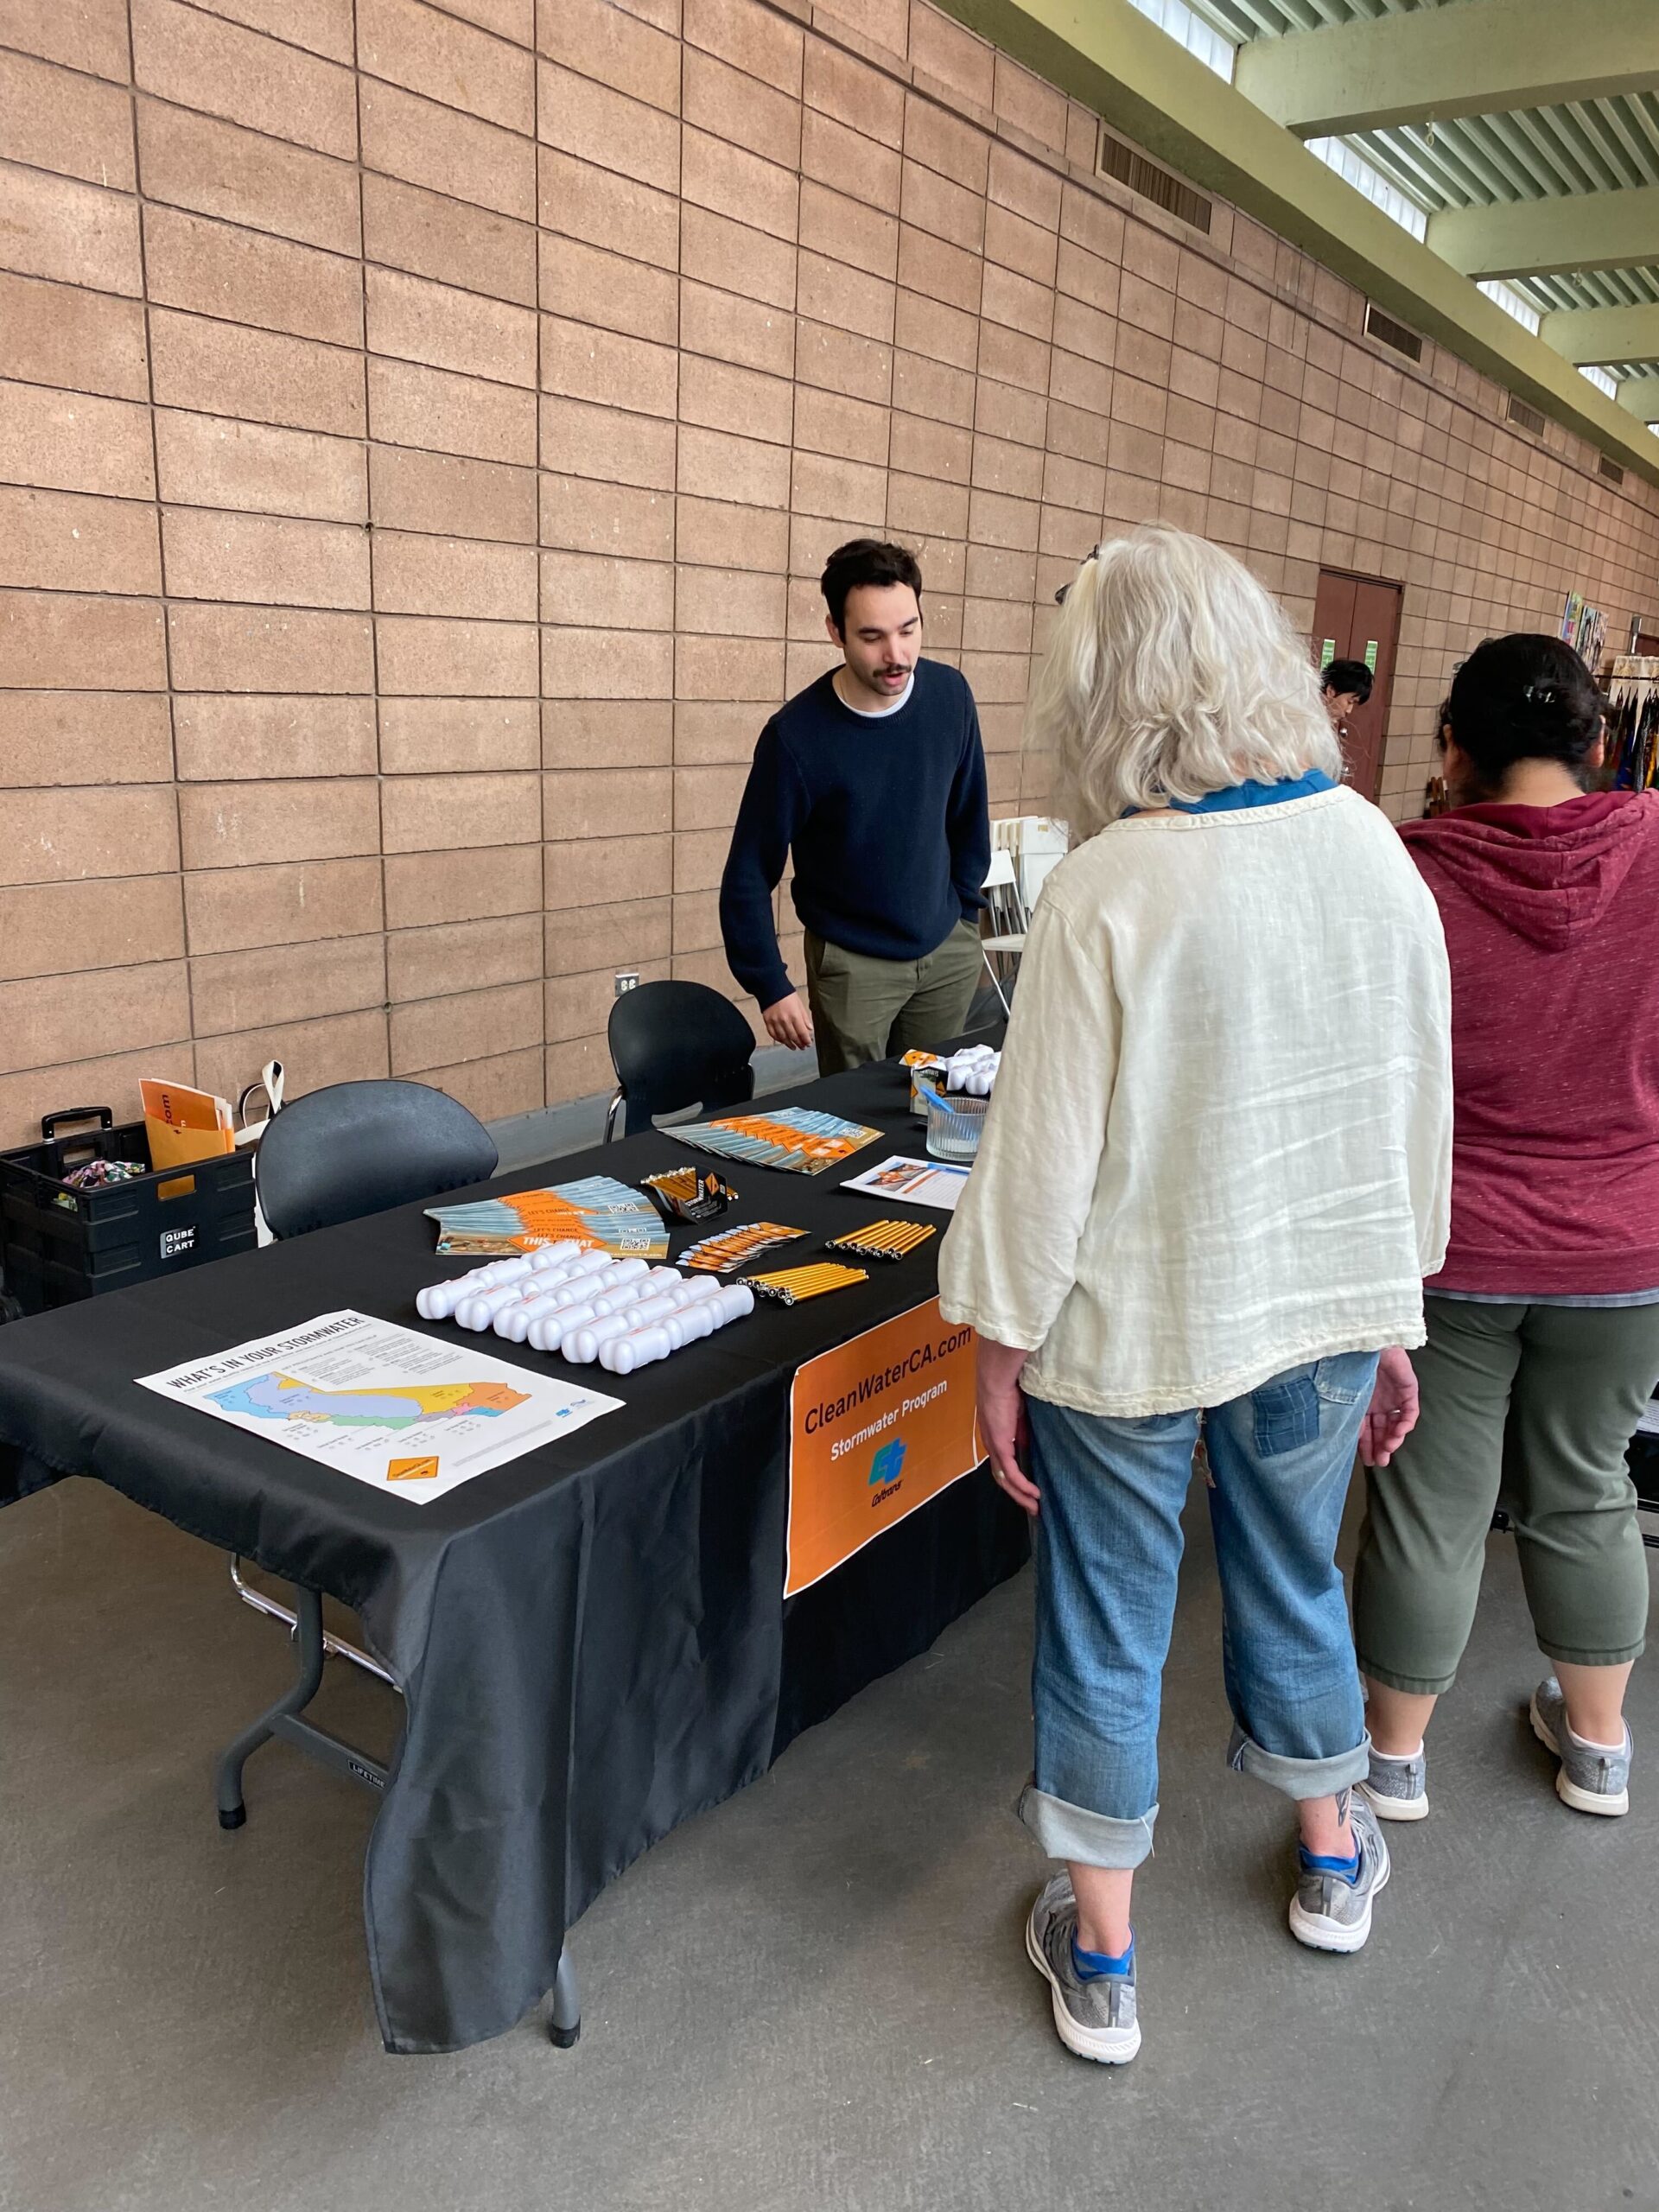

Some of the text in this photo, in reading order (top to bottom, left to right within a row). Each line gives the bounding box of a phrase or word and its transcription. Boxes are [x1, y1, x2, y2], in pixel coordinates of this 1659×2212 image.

[165, 1229, 194, 1243] QUBE
[166, 1239, 194, 1254] CART
[523, 1236, 551, 1245] THIS
[167, 1365, 226, 1389] WHAT'S
[220, 1358, 245, 1370] IN
[238, 1346, 283, 1363] YOUR
[276, 1317, 365, 1351] STORMWATER
[804, 1326, 971, 1434] CleanWaterCA.com
[830, 1380, 947, 1461] Stormwater Program
[871, 1480, 903, 1507] Caltrans
[353, 1764, 385, 1788] LIFETIME
